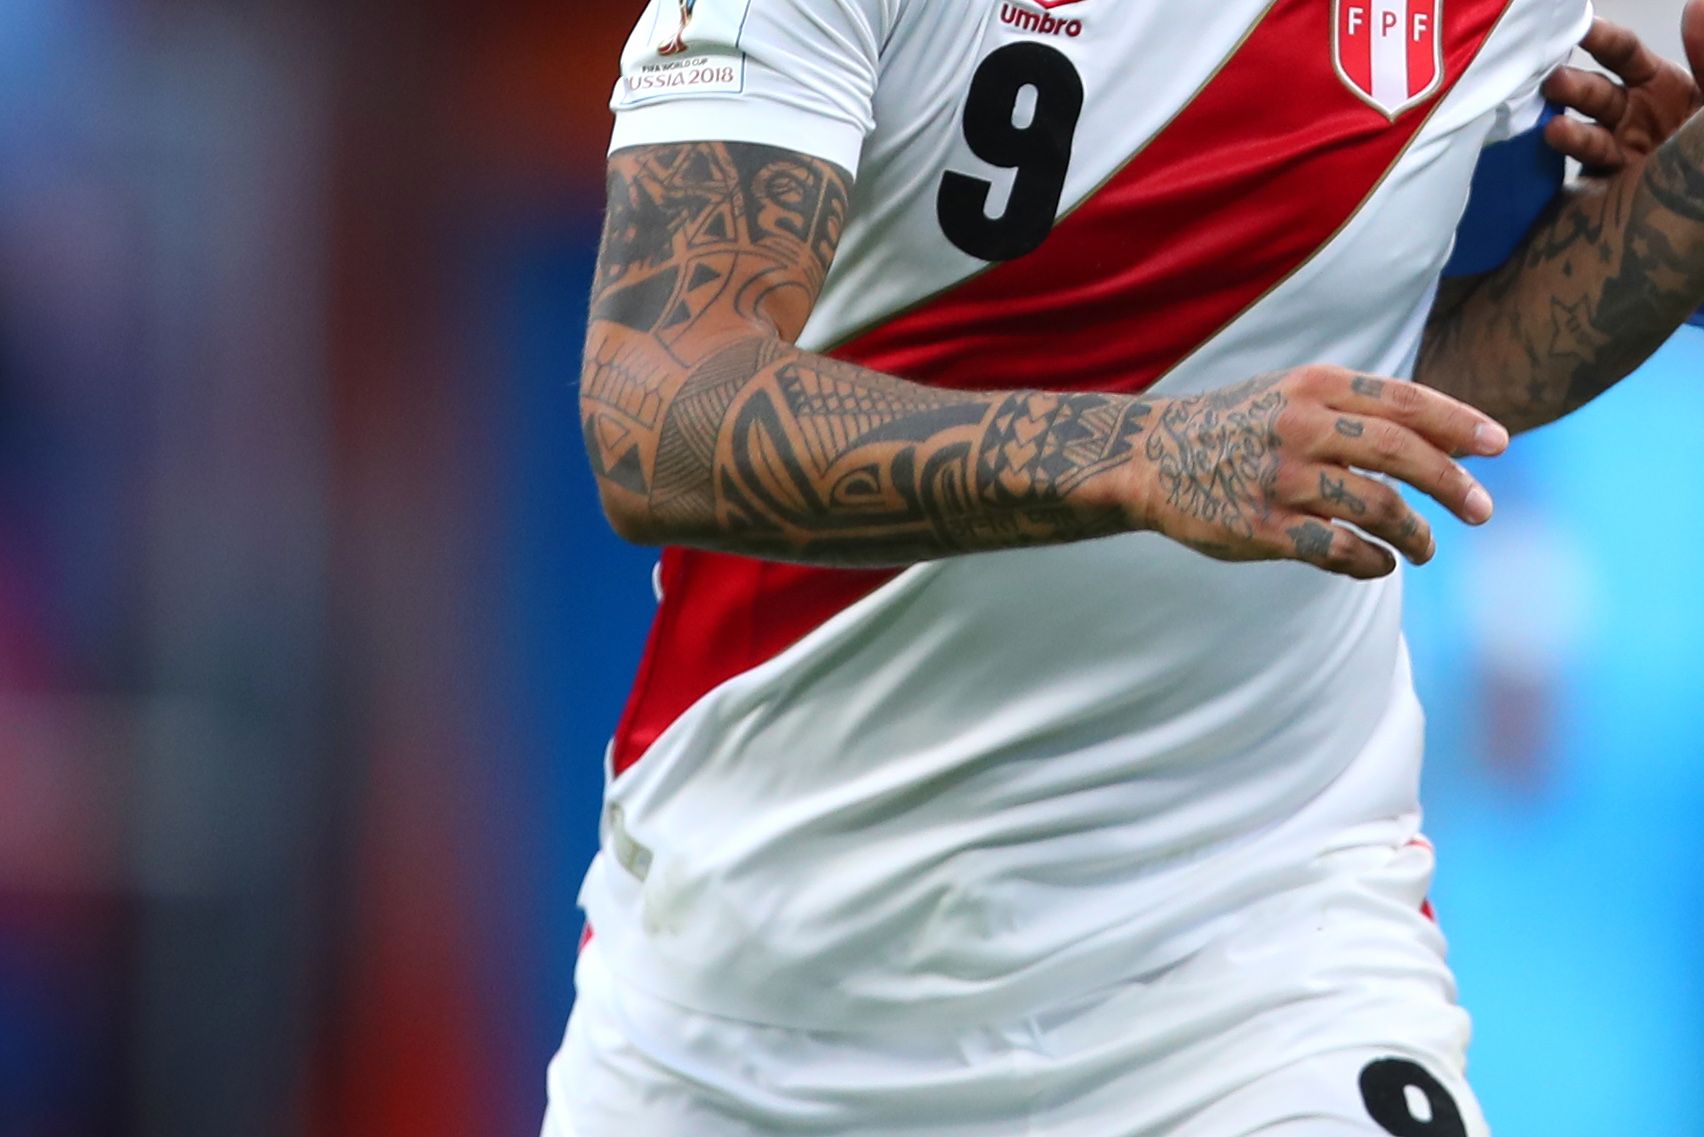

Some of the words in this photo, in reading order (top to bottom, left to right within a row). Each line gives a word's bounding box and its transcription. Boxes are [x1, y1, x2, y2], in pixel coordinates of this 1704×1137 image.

[1000, 3, 1082, 37] umbro
[626, 72, 685, 91] USSIA
[688, 66, 734, 85] 2018
[642, 64, 661, 73] FIFA
[662, 60, 691, 72] WORLD
[691, 58, 708, 66] CUP
[937, 40, 1084, 262] 9
